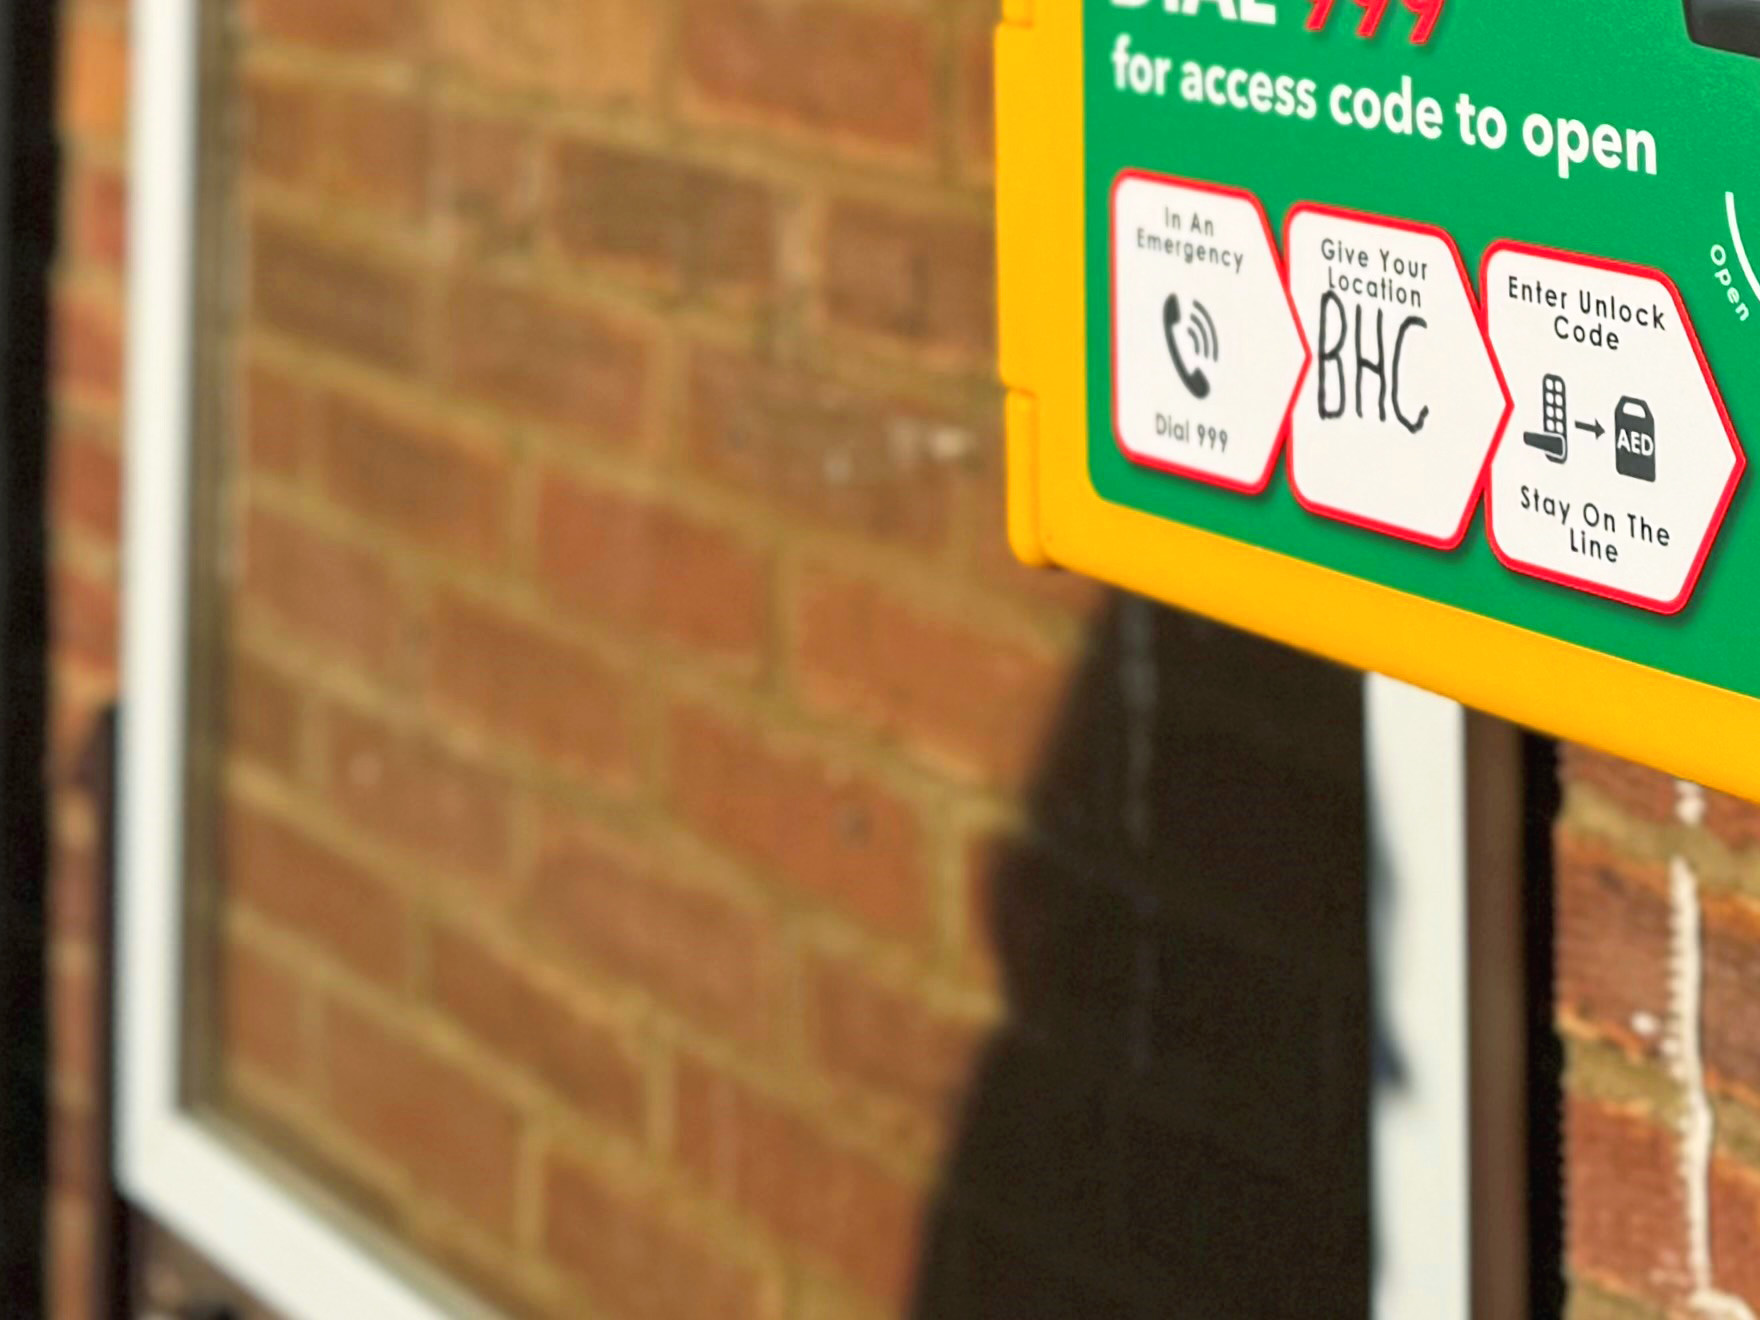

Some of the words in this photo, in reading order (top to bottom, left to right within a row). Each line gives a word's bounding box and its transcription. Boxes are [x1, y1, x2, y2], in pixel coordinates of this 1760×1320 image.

[1111, 33, 1172, 96] for
[1180, 61, 1318, 120] access
[1328, 75, 1445, 141] code
[1455, 93, 1509, 150] to
[1522, 114, 1658, 180] open
[1164, 207, 1182, 230] In
[1189, 213, 1216, 236] An
[1136, 226, 1244, 274] Emergency
[1320, 238, 1370, 269] Give
[1378, 248, 1429, 281] Your
[1327, 268, 1422, 308] Location
[1507, 274, 1570, 312] Enter
[1578, 287, 1667, 332] Unlock
[1709, 243, 1751, 323] Open
[1552, 314, 1621, 352] Code
[1316, 289, 1430, 436] BHC
[1154, 411, 1191, 445] Dial
[1196, 423, 1230, 453] 999
[1616, 426, 1654, 457] AED
[1519, 484, 1572, 526] Stay
[1582, 500, 1617, 534] On
[1626, 509, 1671, 548] The
[1568, 526, 1620, 564] Line
